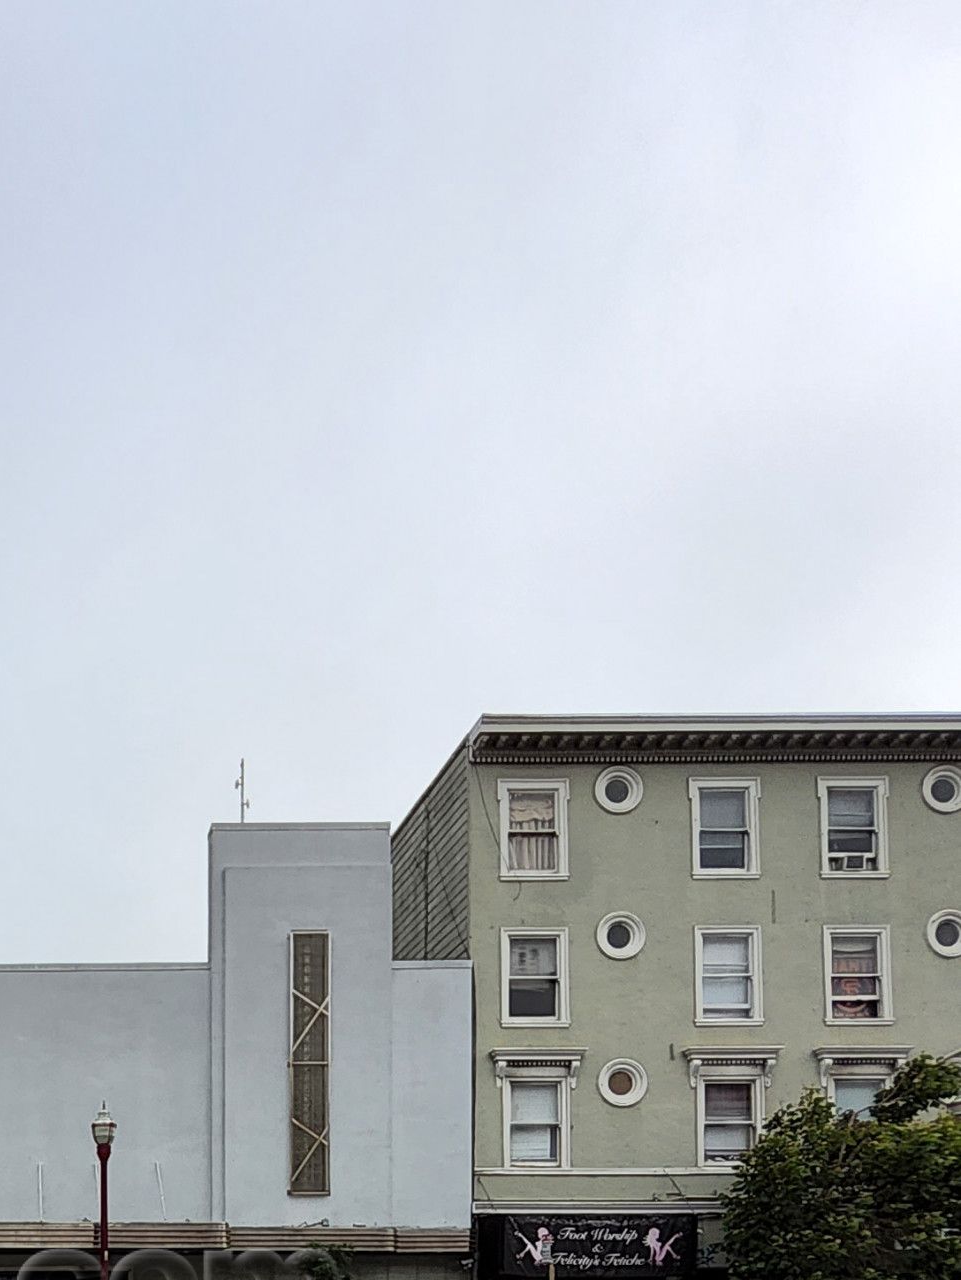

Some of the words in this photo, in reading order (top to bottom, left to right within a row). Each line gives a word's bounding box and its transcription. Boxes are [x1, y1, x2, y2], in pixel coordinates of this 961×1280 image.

[557, 1227, 589, 1240] Foot
[590, 1228, 638, 1245] Worship
[591, 1243, 605, 1253] &
